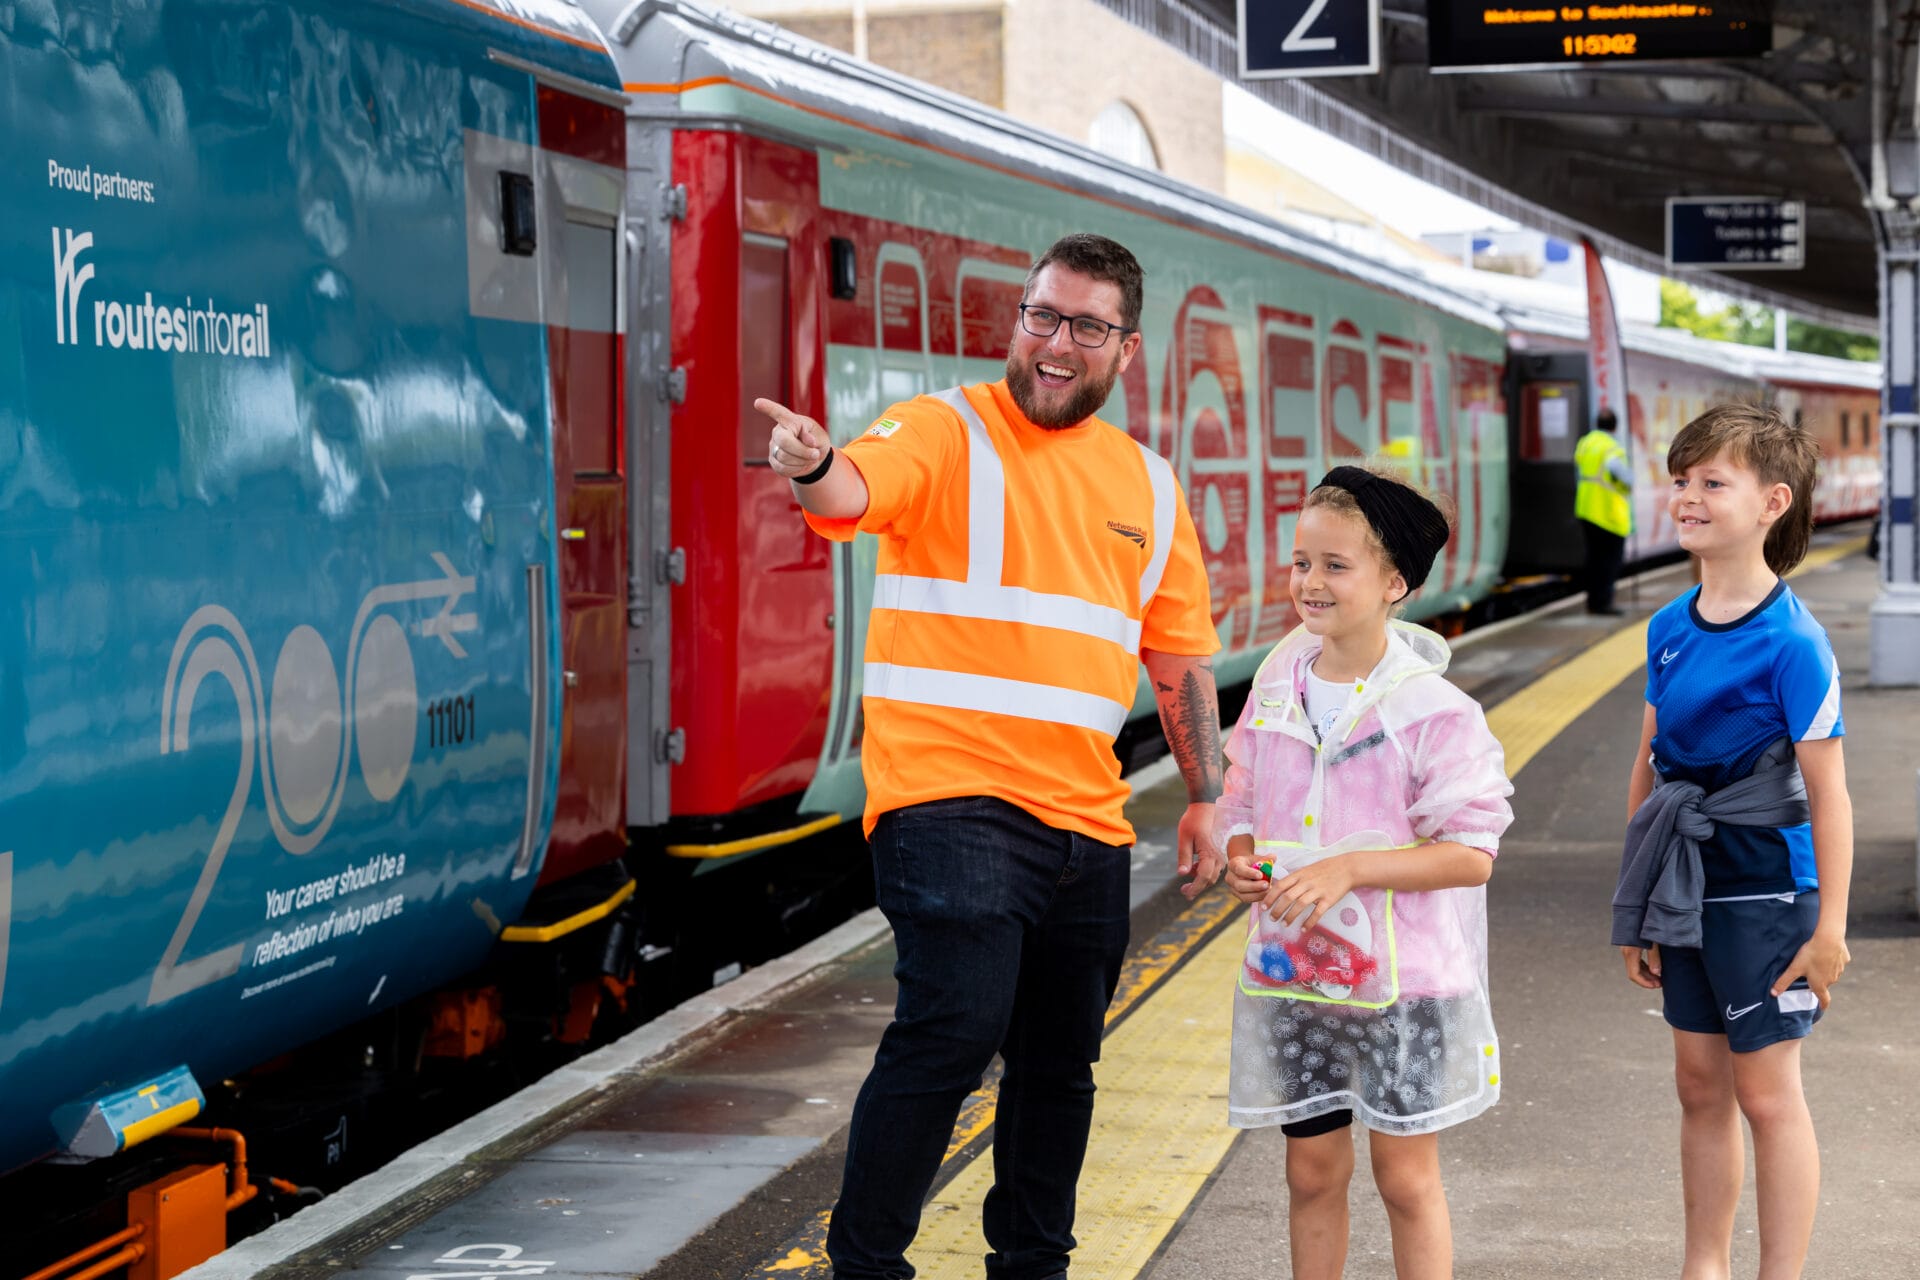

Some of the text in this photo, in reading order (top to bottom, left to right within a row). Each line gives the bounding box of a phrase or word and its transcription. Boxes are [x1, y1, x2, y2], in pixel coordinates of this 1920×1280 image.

[1280, 0, 1337, 52] 2
[1483, 8, 1557, 25] Welcome
[1560, 6, 1583, 22] to
[48, 159, 155, 203] Proud partners:
[426, 693, 476, 749] 11101
[265, 852, 406, 920] Your career should be a
[252, 922, 319, 968] reflection
[317, 910, 337, 944] of
[332, 905, 361, 938] who
[357, 901, 385, 935] you
